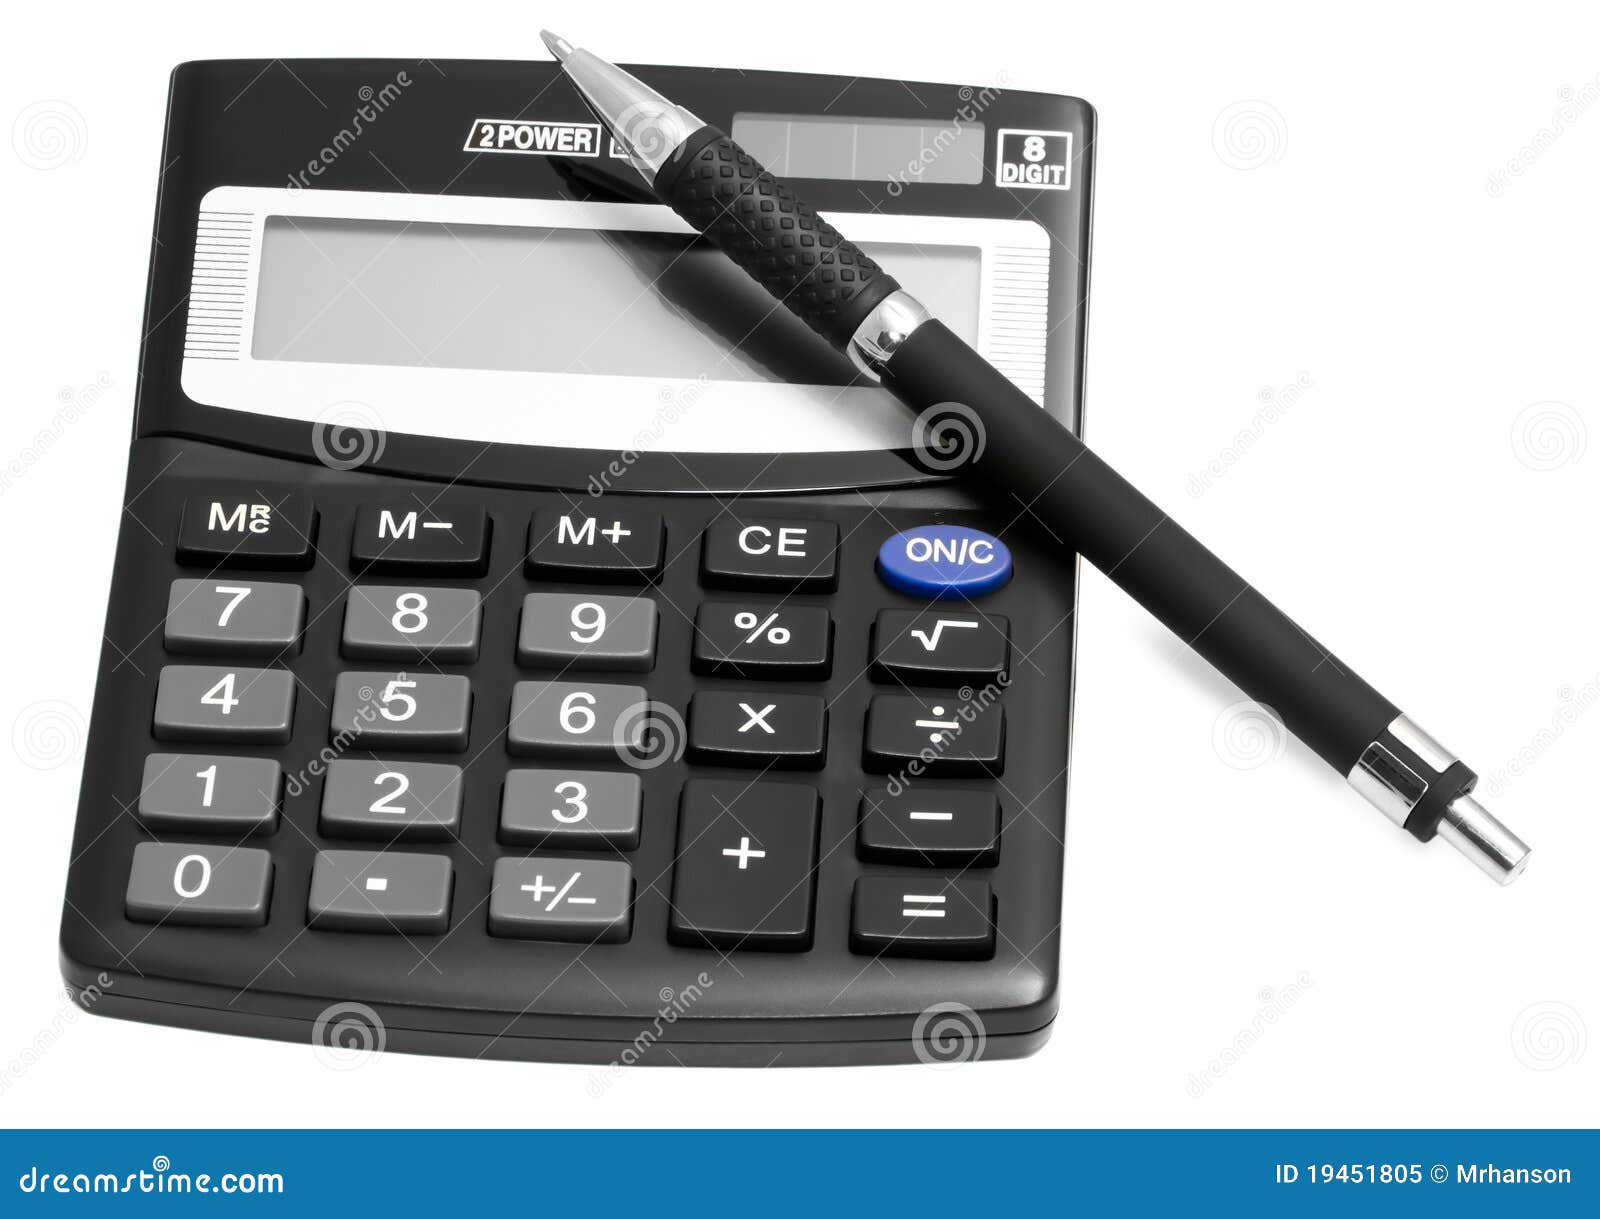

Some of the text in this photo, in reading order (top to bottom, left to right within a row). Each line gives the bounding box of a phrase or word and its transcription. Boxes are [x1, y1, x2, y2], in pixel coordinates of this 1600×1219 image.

[1023, 136, 1046, 162] 8
[1003, 162, 1065, 184] DIGIT
[557, 516, 631, 546] M+
[738, 526, 807, 557] CE
[906, 537, 994, 566] ON/C
[215, 586, 252, 627] 7
[391, 592, 428, 634] 8
[570, 602, 607, 644] 9
[734, 612, 791, 644] %
[200, 673, 239, 715] 4
[379, 680, 417, 722] 5
[559, 691, 596, 734] 6
[196, 764, 217, 807] 1
[369, 771, 410, 814] 2
[551, 781, 588, 824] 3
[722, 837, 766, 869] +
[173, 854, 212, 898] 0
[902, 895, 946, 917] =
